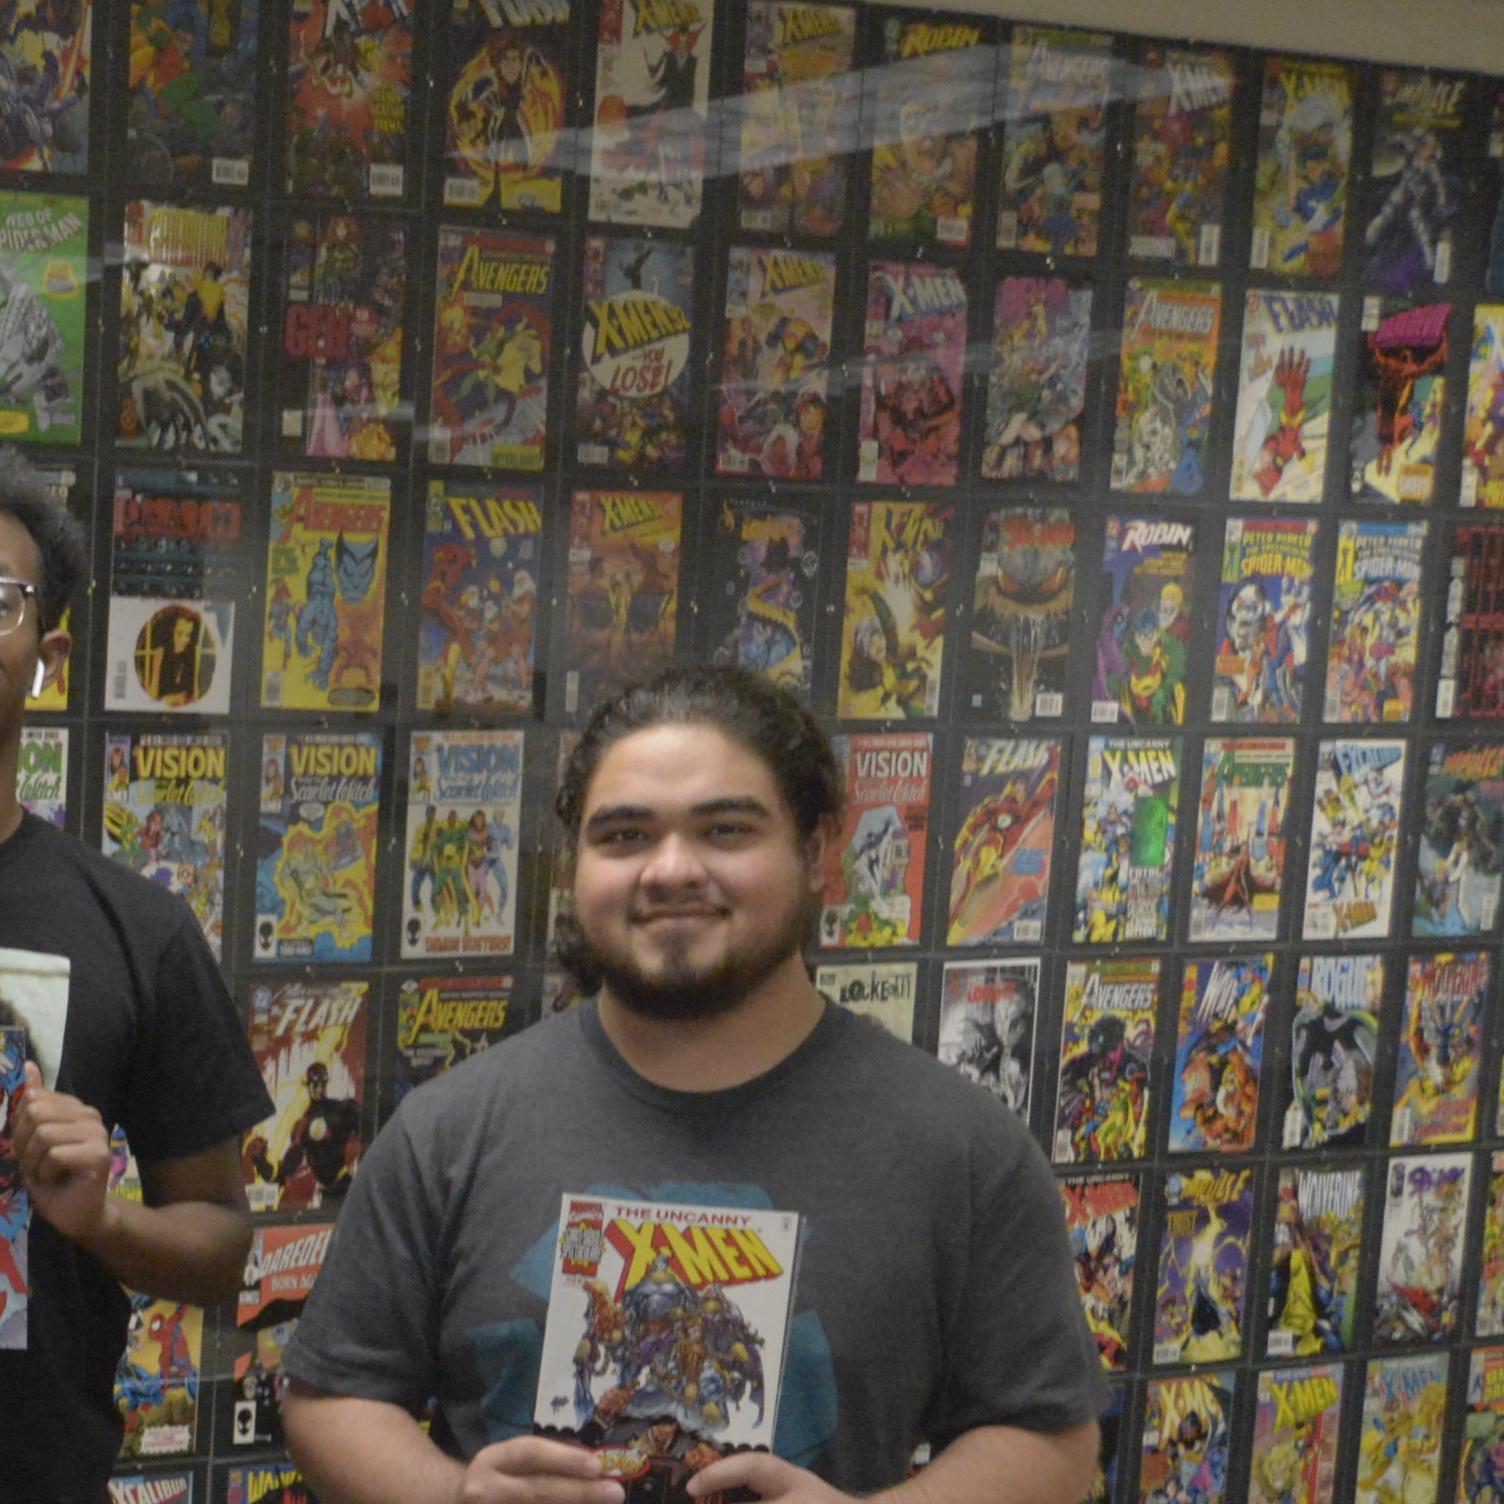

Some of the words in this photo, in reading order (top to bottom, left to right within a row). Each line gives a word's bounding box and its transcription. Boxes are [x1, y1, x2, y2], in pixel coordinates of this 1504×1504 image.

[901, 23, 980, 56] ROBIN
[5, 211, 33, 228] WEB
[451, 246, 550, 301] AVENGERS
[890, 272, 968, 319] X-MEN
[1262, 294, 1342, 334] FLASH
[1130, 291, 1213, 340] AVENGERS
[609, 360, 673, 394] LOSE!
[448, 496, 542, 540] FLASH
[1122, 521, 1192, 553] ROBIN
[134, 748, 225, 780] VISION
[291, 746, 377, 777] VISION
[435, 747, 520, 777] VISION
[1107, 740, 1124, 750] THE
[1125, 741, 1170, 751] UNCANNY
[855, 752, 928, 780] VISION
[1102, 749, 1176, 789] X-MEN
[291, 778, 336, 802] Scarlet
[337, 777, 375, 801] Witch
[1081, 974, 1154, 1012] AVENGERS
[277, 998, 363, 1036] FLASH
[400, 989, 509, 1050] AVENGERS
[1300, 1172, 1364, 1220] WOLVERINE
[615, 1206, 652, 1219] THE
[656, 1210, 752, 1227] UNCANNY
[261, 1230, 334, 1277] DAREDE
[604, 1217, 785, 1303] X-MEN
[271, 1273, 299, 1291] BORN
[1271, 1379, 1339, 1432] X-MEN
